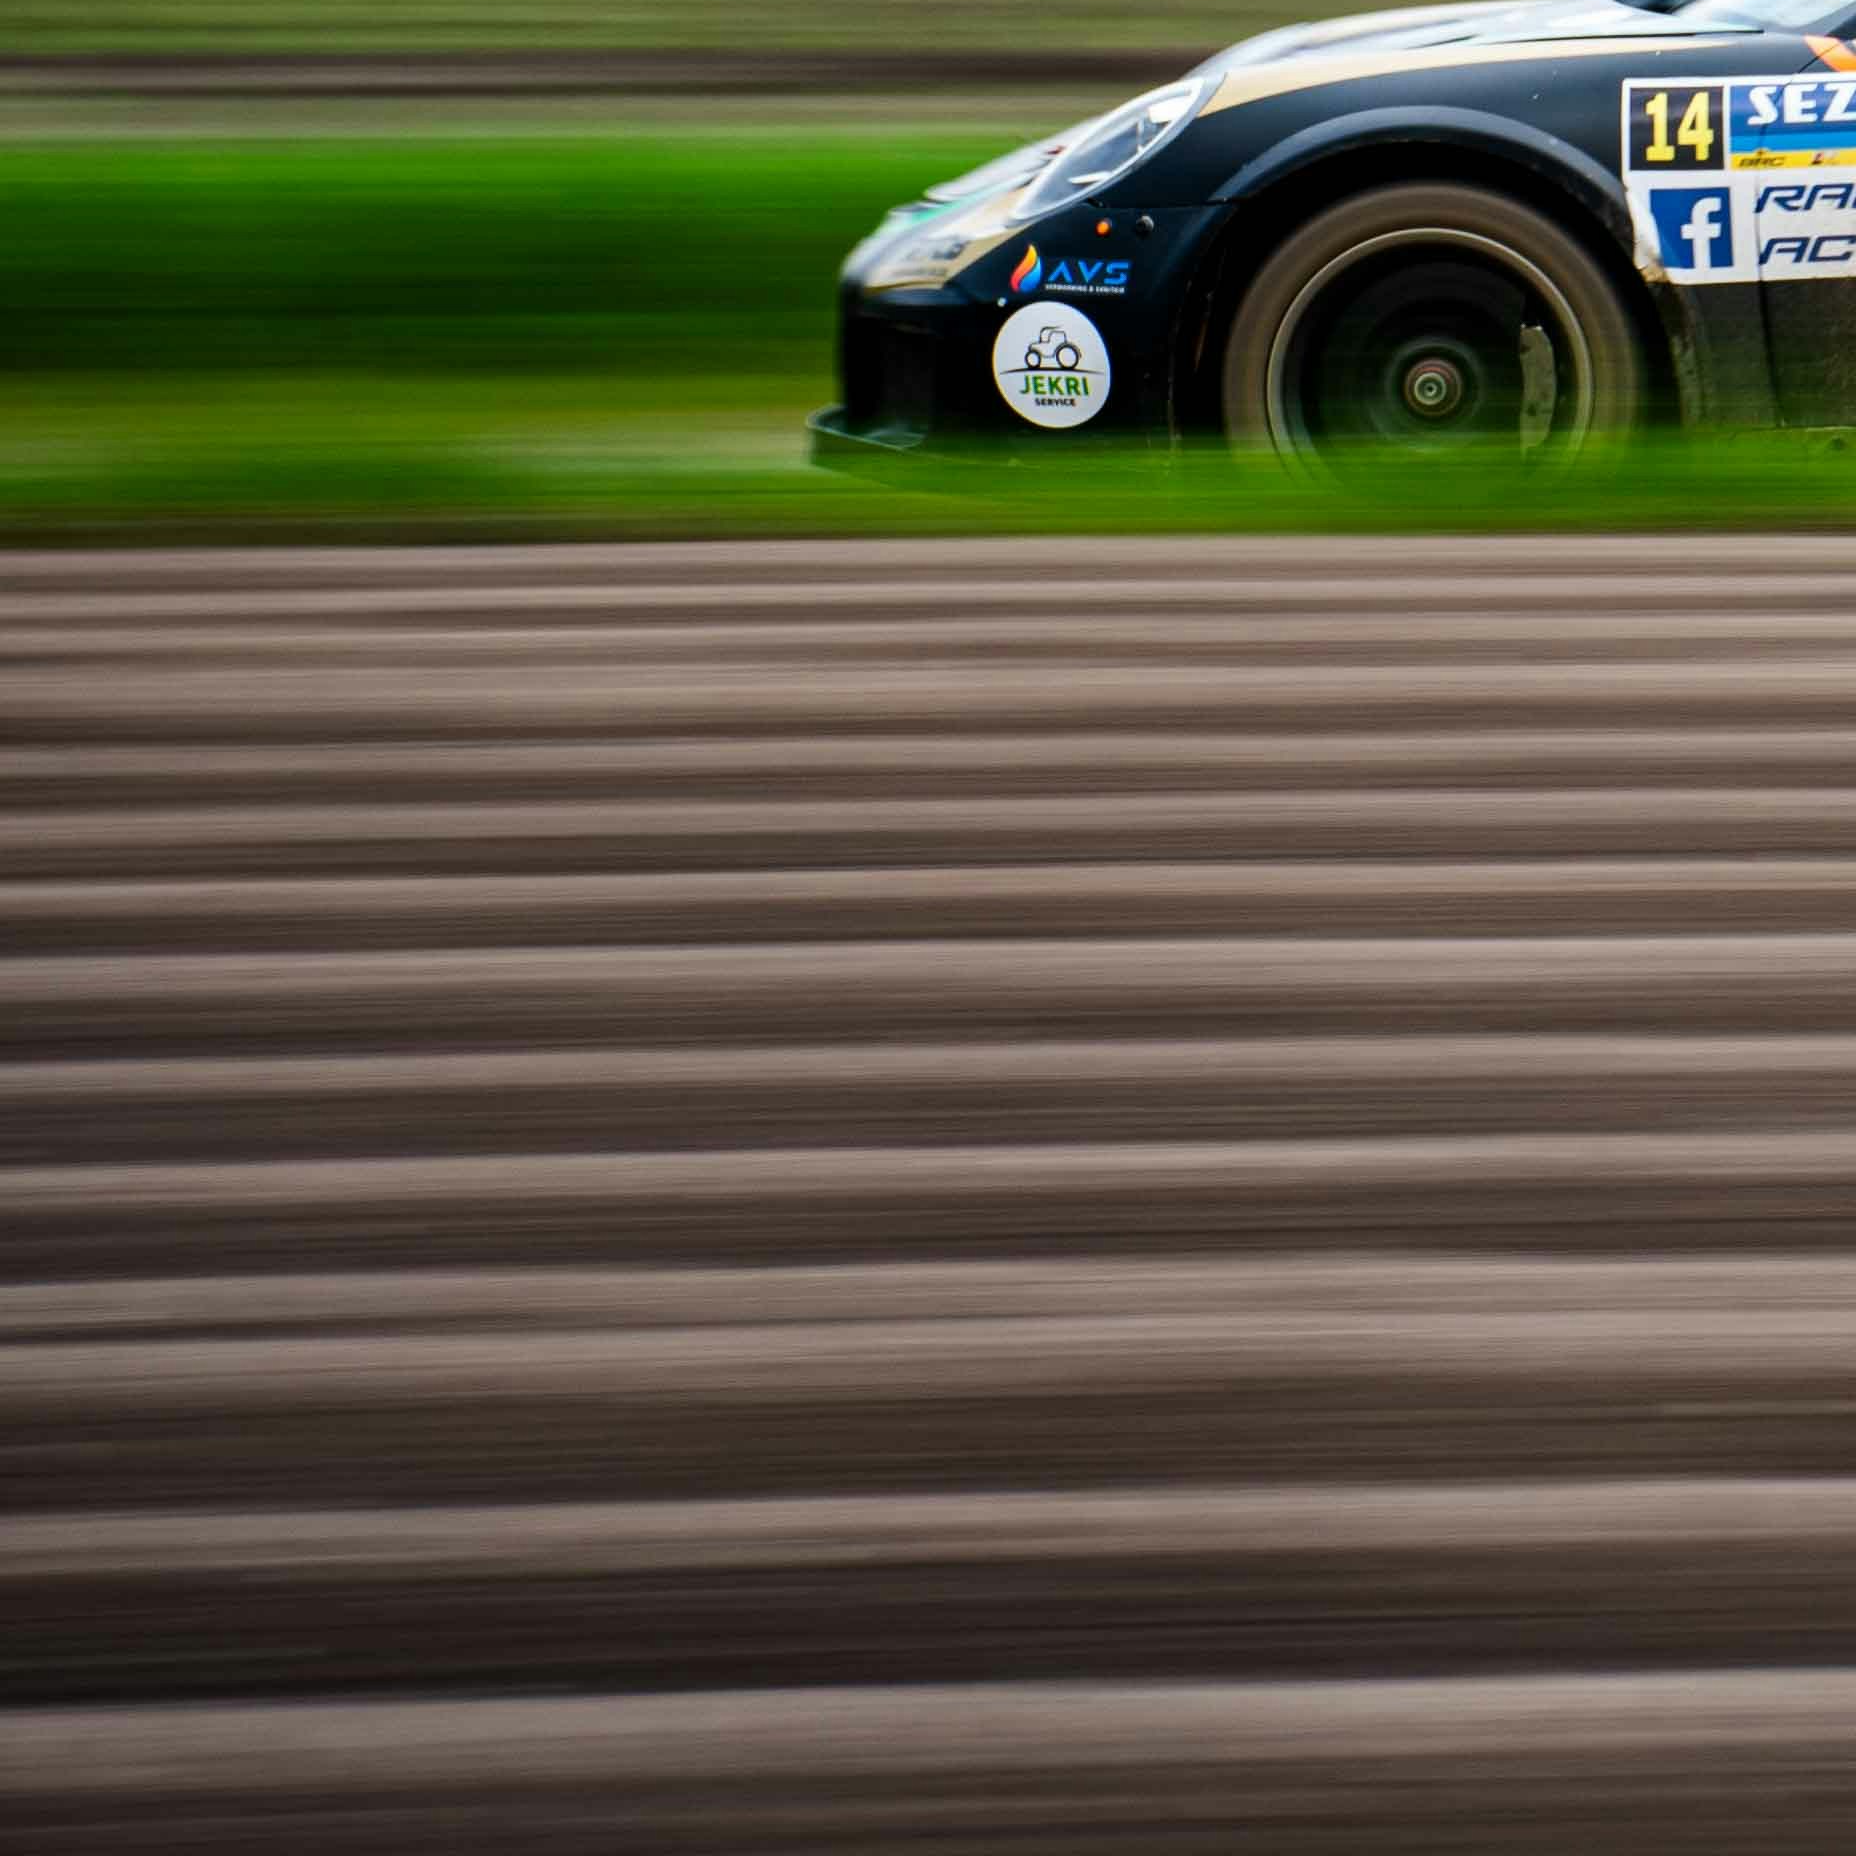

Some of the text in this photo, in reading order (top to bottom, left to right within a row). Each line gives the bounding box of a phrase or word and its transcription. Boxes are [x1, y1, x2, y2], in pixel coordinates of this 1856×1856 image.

[1645, 91, 1714, 162] 14
[1046, 260, 1131, 286] AVS
[1019, 375, 1090, 396] JEKRI
[1034, 397, 1077, 407] SERVICE
